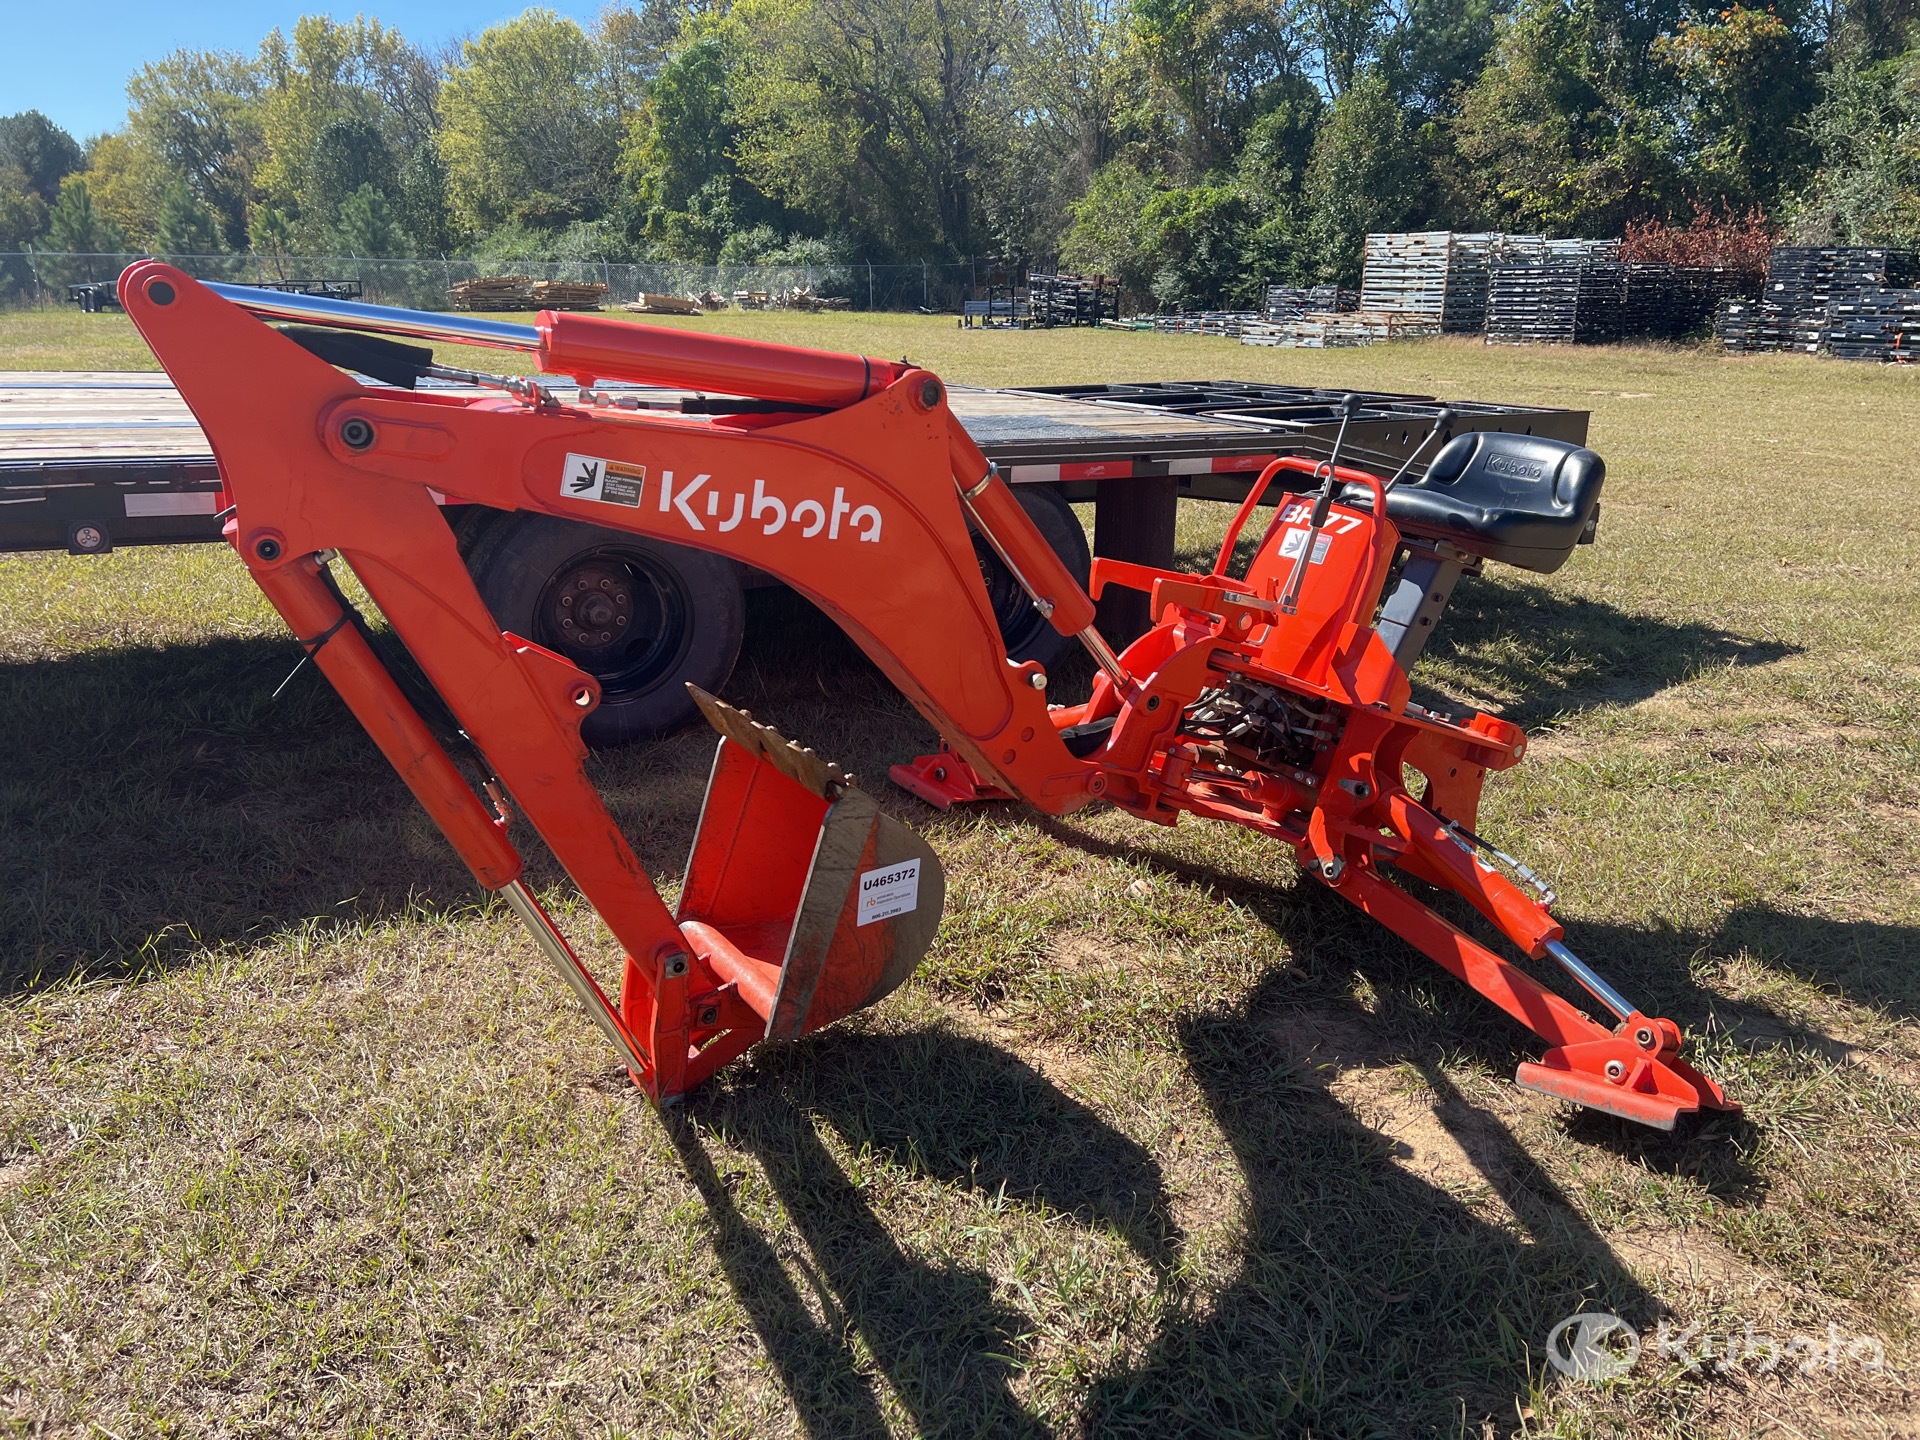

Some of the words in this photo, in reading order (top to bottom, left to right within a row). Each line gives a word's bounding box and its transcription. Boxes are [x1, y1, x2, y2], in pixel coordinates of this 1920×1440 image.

[615, 466, 640, 474] WARNING
[1489, 456, 1542, 478] Kubota
[659, 470, 882, 543] Kubota
[864, 868, 915, 890] U465372
[866, 897, 876, 908] rb
